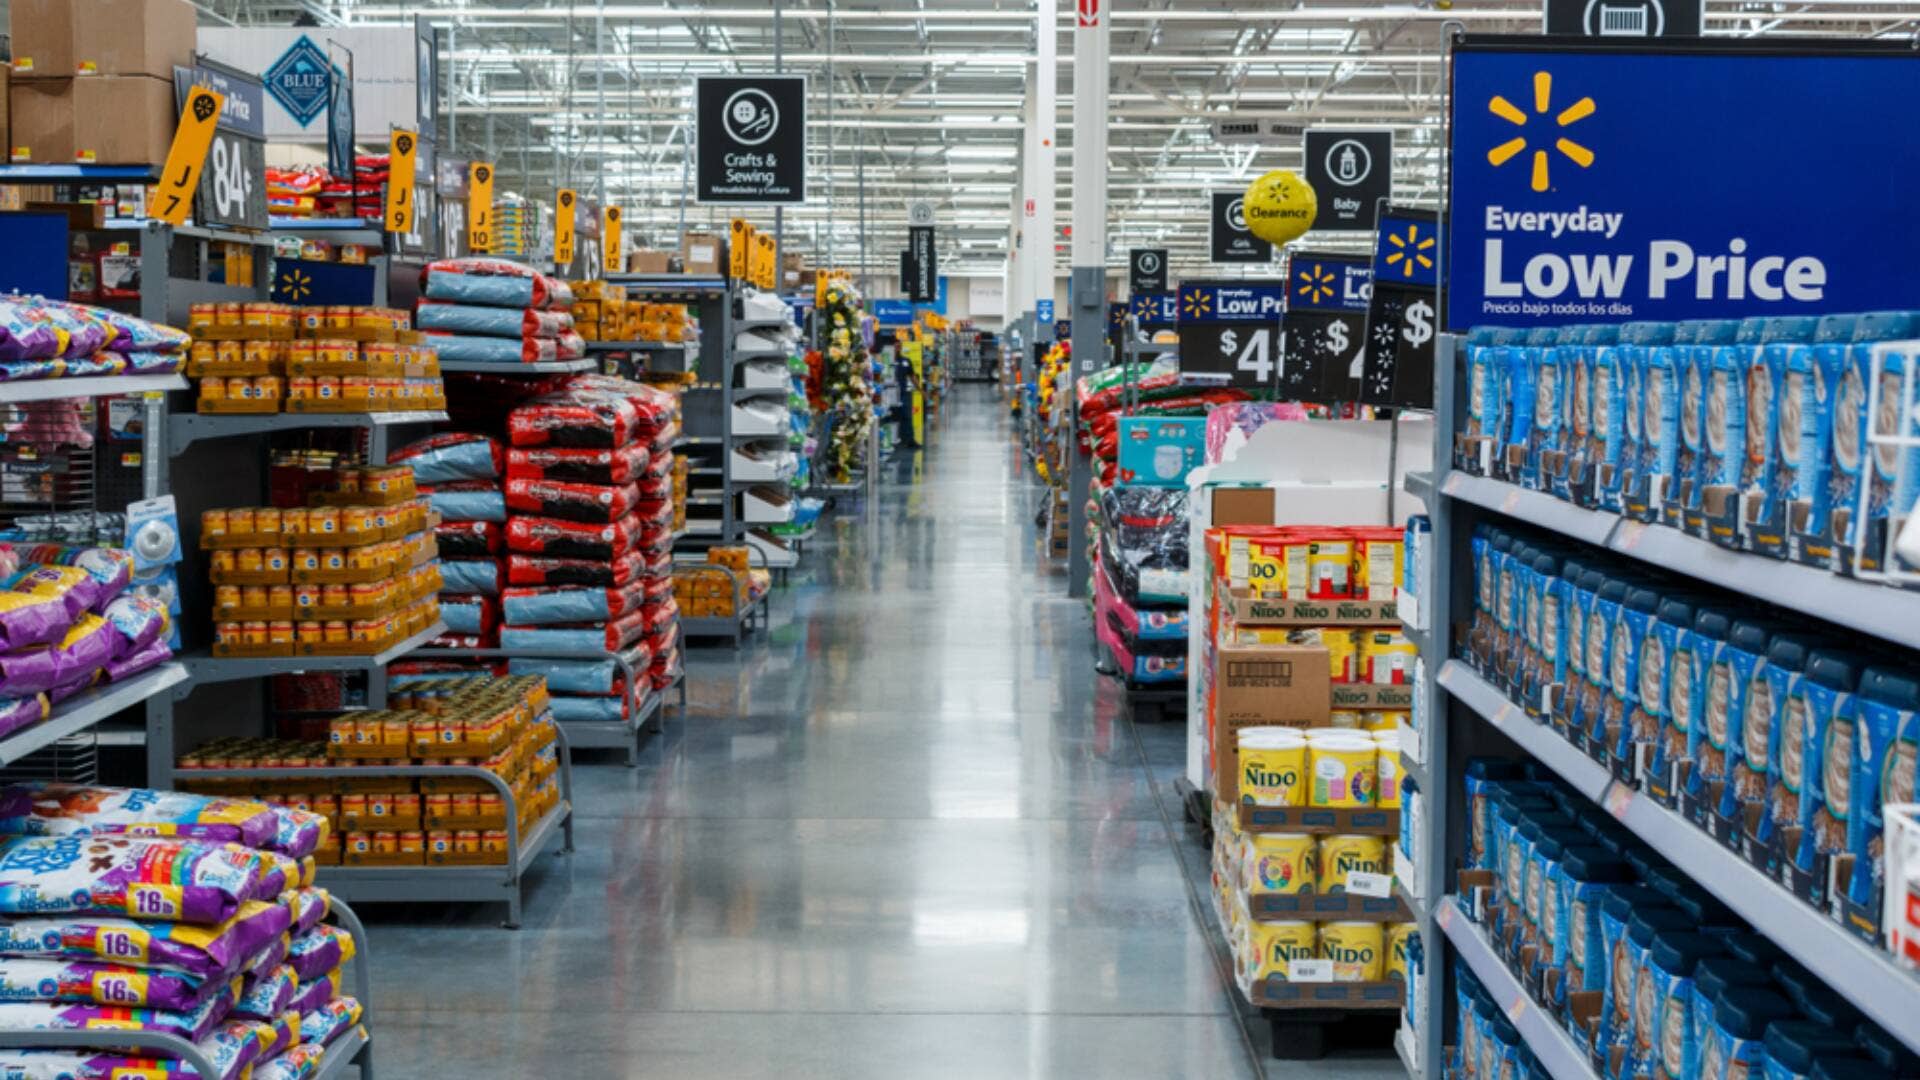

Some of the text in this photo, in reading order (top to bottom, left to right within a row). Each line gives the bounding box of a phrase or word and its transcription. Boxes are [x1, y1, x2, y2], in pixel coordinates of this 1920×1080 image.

[284, 75, 325, 88] BLUE
[724, 153, 777, 167] Crafts &
[174, 166, 191, 188] J
[726, 169, 775, 186] Sewing
[163, 195, 181, 216] 7
[397, 188, 406, 206] J
[1334, 198, 1361, 211] Baby
[394, 211, 405, 228] 9
[477, 211, 486, 226] J
[1250, 207, 1308, 219] Clearance
[1485, 205, 1624, 239] Everyday
[472, 231, 488, 246] 10
[607, 258, 618, 269] 12
[1484, 237, 1827, 301] Low Price
[1217, 296, 1259, 314] Low
[1483, 302, 1633, 317] Precio bajo todos los días
[1403, 300, 1435, 349] $
[1251, 606, 1285, 619] NIDO
[1294, 606, 1329, 619] NIDO
[1337, 607, 1372, 619] NIDO
[1334, 691, 1369, 704] NIDO
[1246, 768, 1297, 788] NIDO
[135, 889, 162, 915] 16
[104, 932, 130, 956] 16
[1323, 943, 1374, 964] NIDO
[101, 979, 127, 1002] 16
